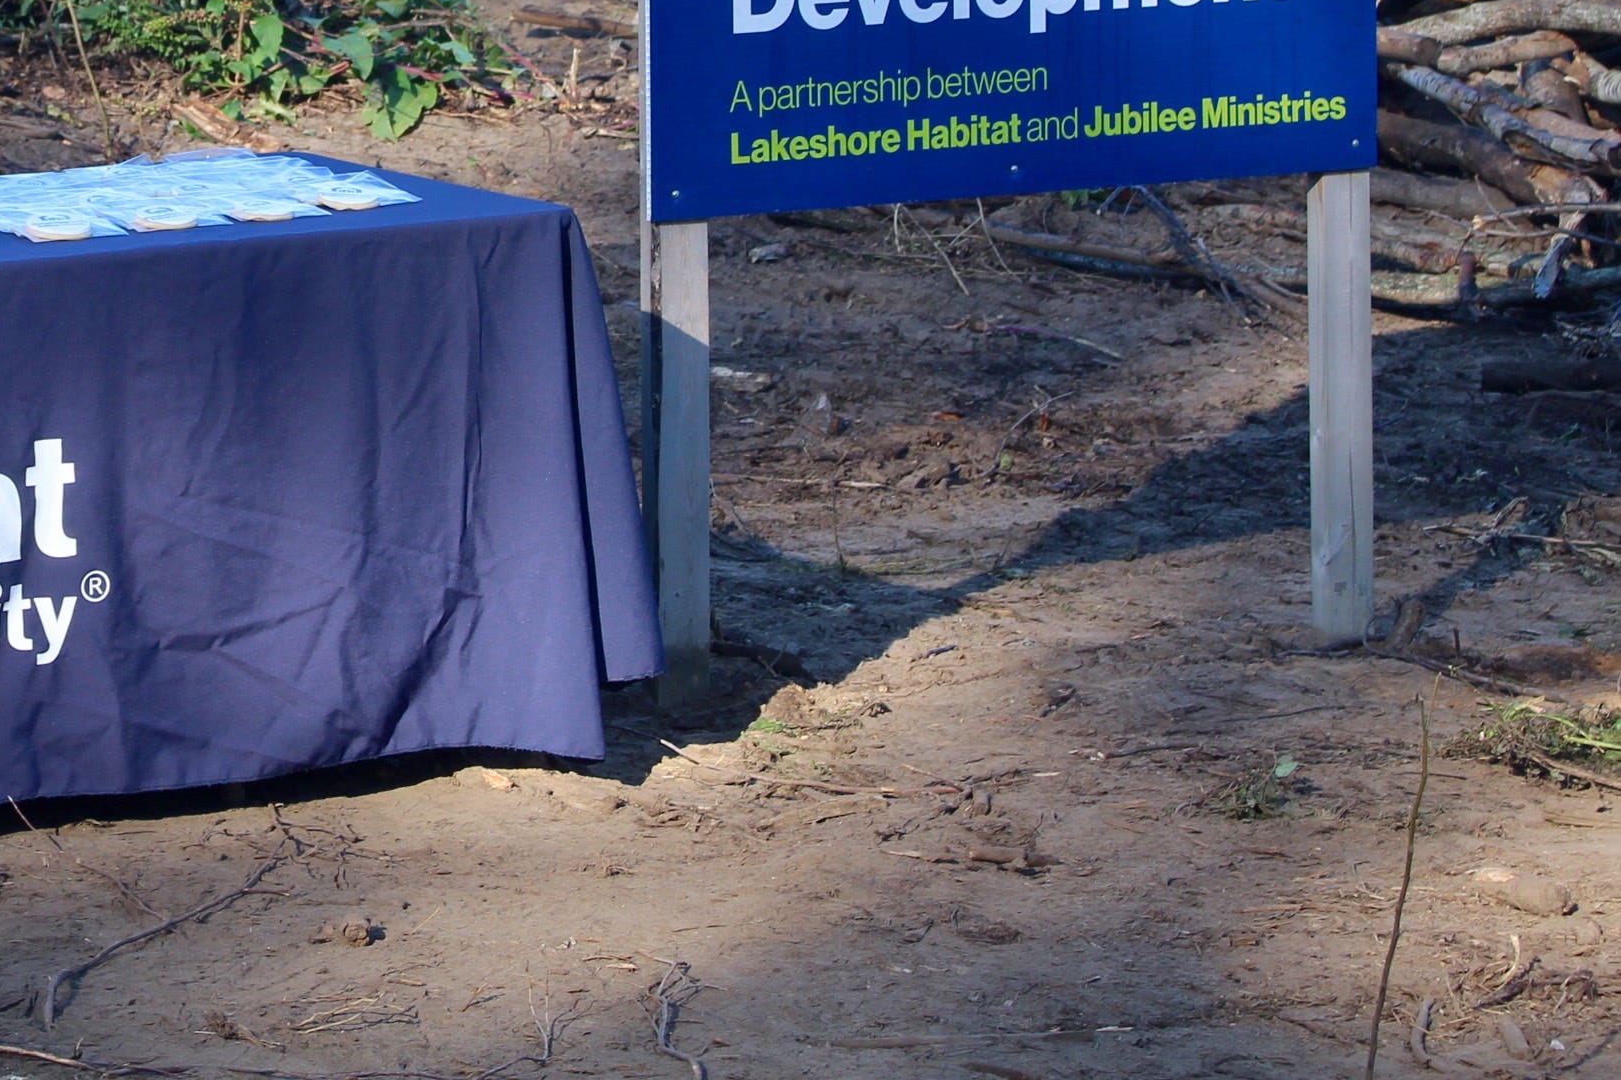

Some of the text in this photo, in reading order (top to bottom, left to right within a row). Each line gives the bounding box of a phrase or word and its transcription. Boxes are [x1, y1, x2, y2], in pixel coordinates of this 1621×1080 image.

[730, 66, 1047, 117] A partnership between
[731, 91, 1346, 164] Lakeshore Habitat and Jubilee Ministries
